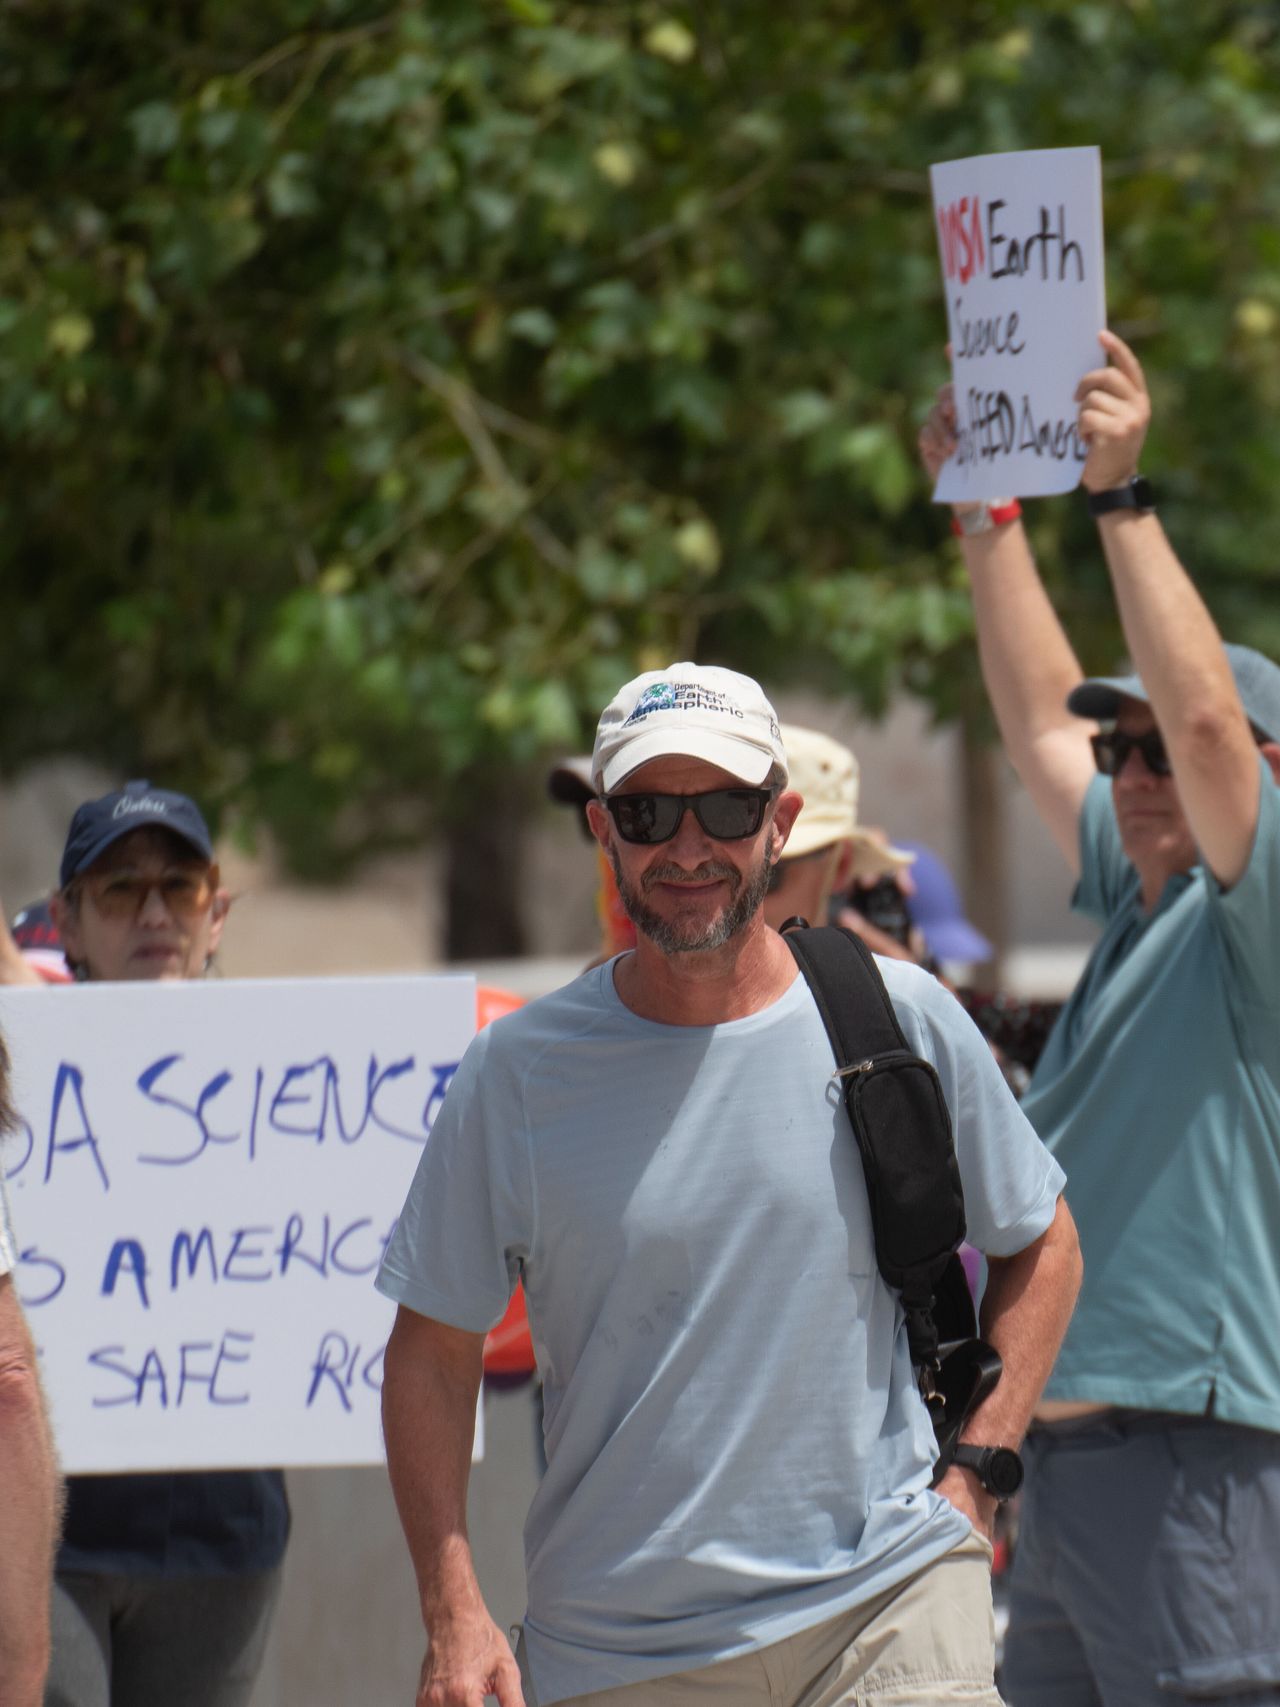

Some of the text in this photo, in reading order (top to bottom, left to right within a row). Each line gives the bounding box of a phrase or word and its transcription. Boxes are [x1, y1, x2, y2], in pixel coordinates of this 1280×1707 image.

[987, 198, 1084, 282] Earth
[674, 683, 716, 697] Department
[674, 690, 722, 705] Earth
[87, 1328, 255, 1410] SAFE
